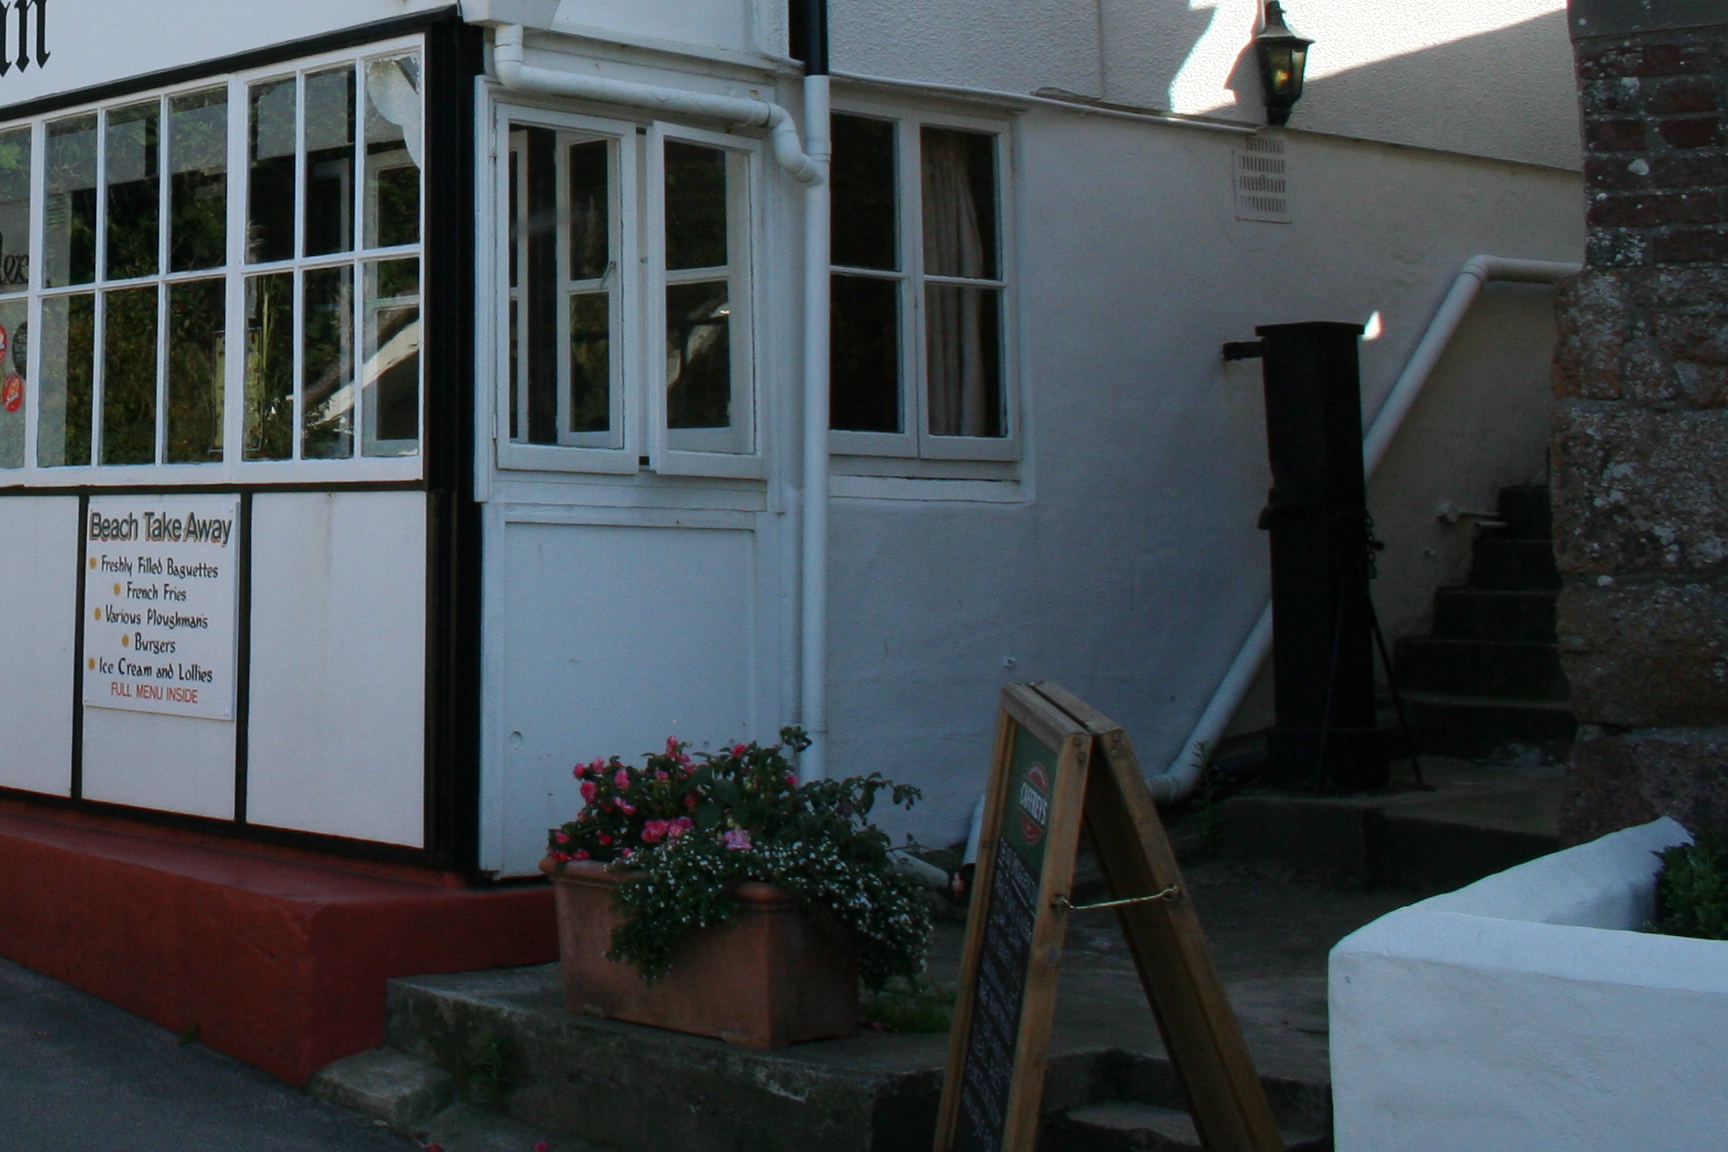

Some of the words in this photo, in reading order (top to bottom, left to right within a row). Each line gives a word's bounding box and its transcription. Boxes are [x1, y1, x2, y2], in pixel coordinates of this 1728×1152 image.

[89, 512, 139, 542] Beach
[143, 512, 182, 542] Take
[183, 511, 232, 547] Away
[101, 554, 133, 577] Freshly
[138, 556, 163, 575] Filled
[167, 557, 219, 579] Baguettes
[127, 581, 158, 599] French
[163, 583, 187, 601] Fries
[106, 604, 141, 625] Various
[135, 632, 176, 654] Burgers
[99, 657, 114, 674] Ice
[118, 657, 152, 677] Cream
[156, 663, 174, 680] and
[179, 663, 213, 683] Lollies
[111, 681, 132, 697] FULL
[136, 684, 163, 700] MENU
[167, 687, 198, 704] INSIDE
